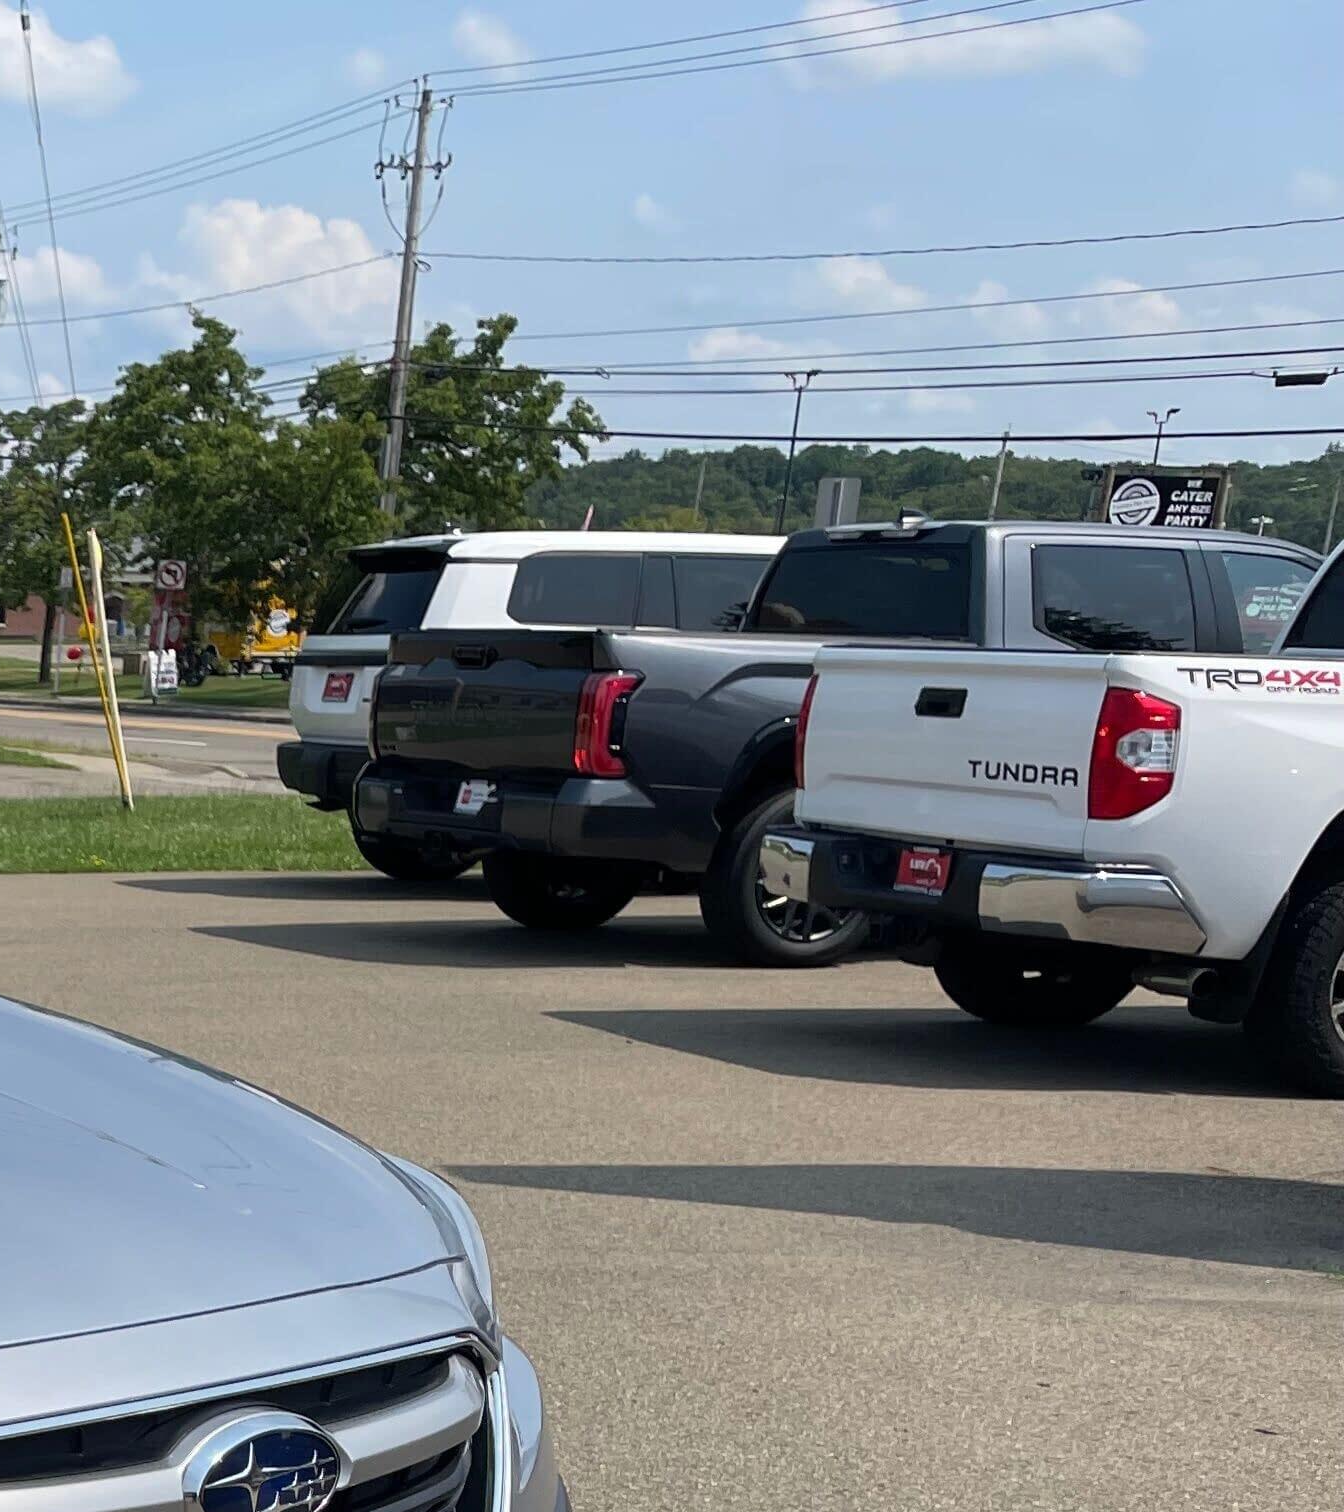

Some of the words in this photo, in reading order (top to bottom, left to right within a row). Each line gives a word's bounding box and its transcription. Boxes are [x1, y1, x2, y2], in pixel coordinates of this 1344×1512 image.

[1171, 489, 1213, 503] CATER
[1167, 503, 1189, 513] ANY
[1164, 515, 1208, 527] PARTY
[1177, 667, 1263, 691] TRD
[968, 760, 1079, 788] TUNDRA
